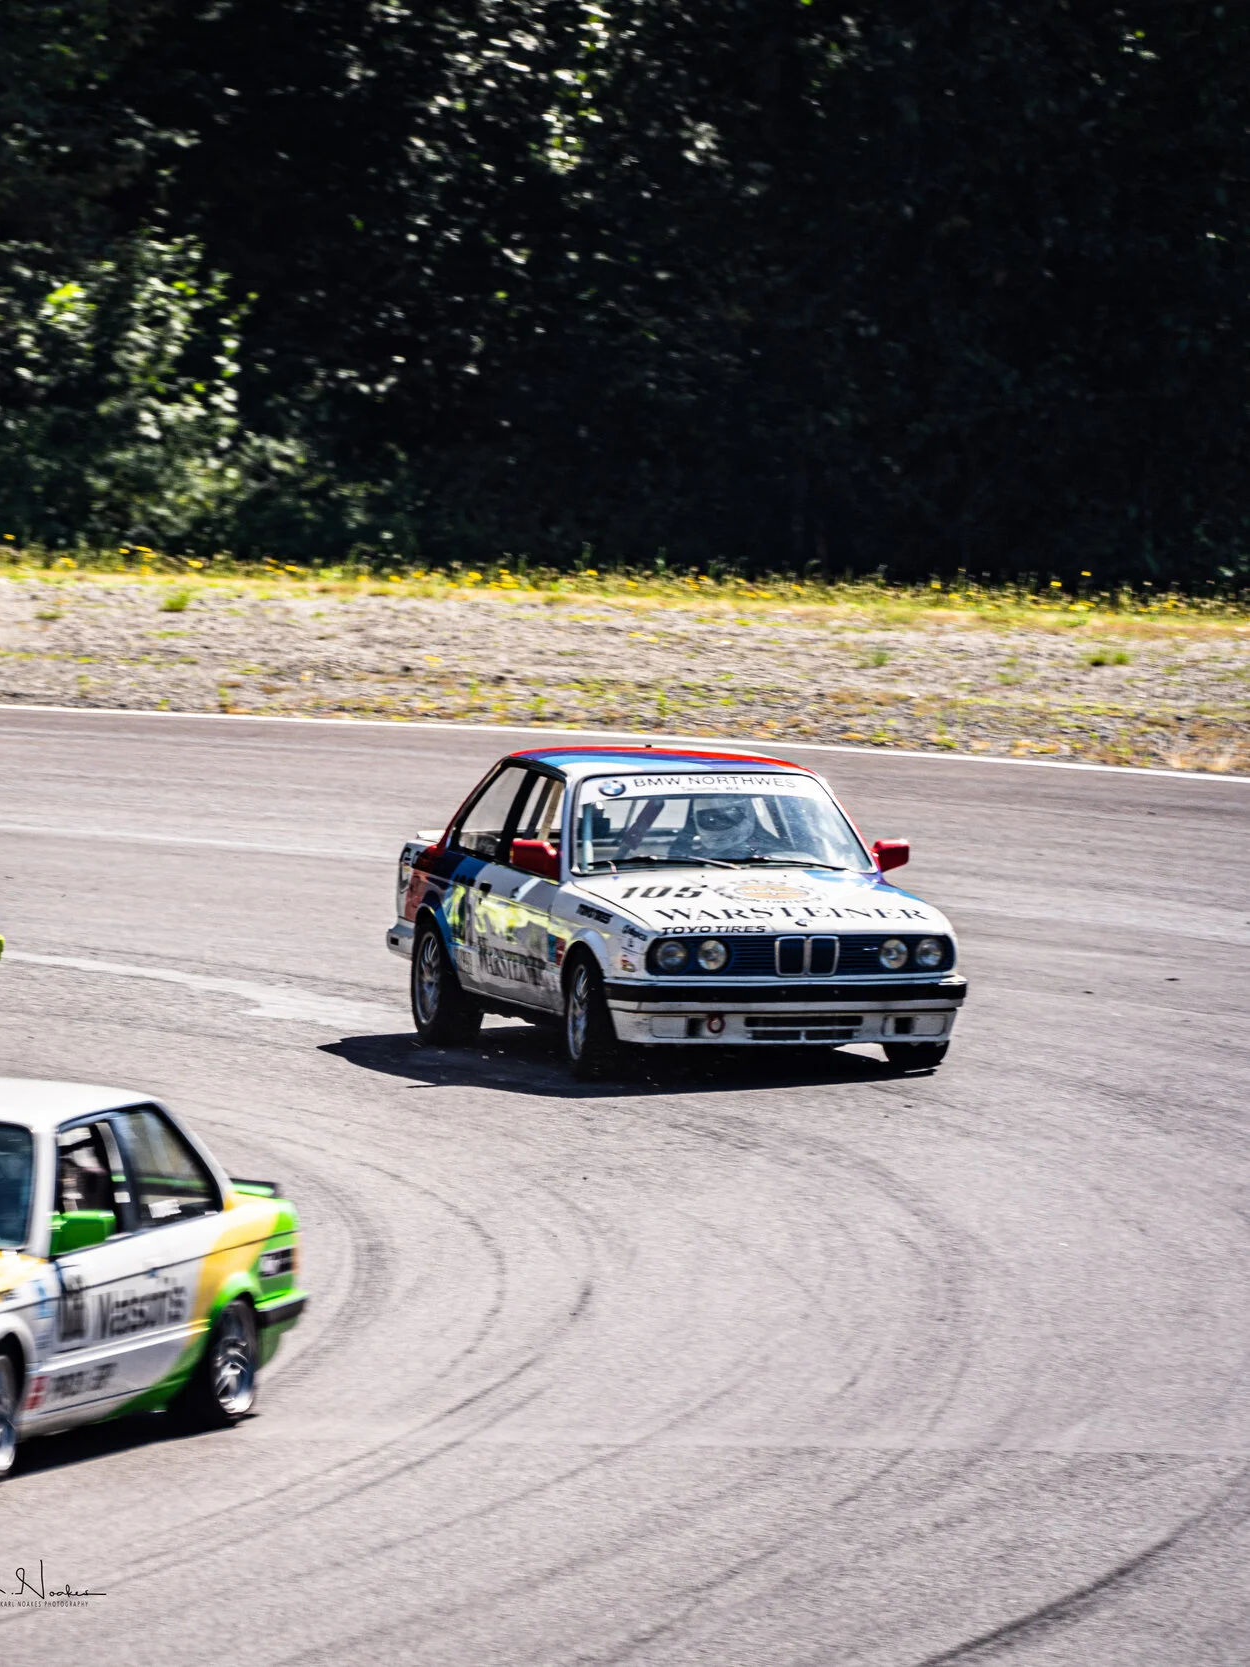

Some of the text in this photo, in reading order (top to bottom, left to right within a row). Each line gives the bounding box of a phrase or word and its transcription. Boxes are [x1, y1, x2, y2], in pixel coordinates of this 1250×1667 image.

[633, 776, 680, 788] BMW
[621, 886, 703, 900] 105
[654, 906, 929, 921] WARSTEINER
[658, 926, 711, 935] TOYO
[715, 925, 766, 933] TIRES
